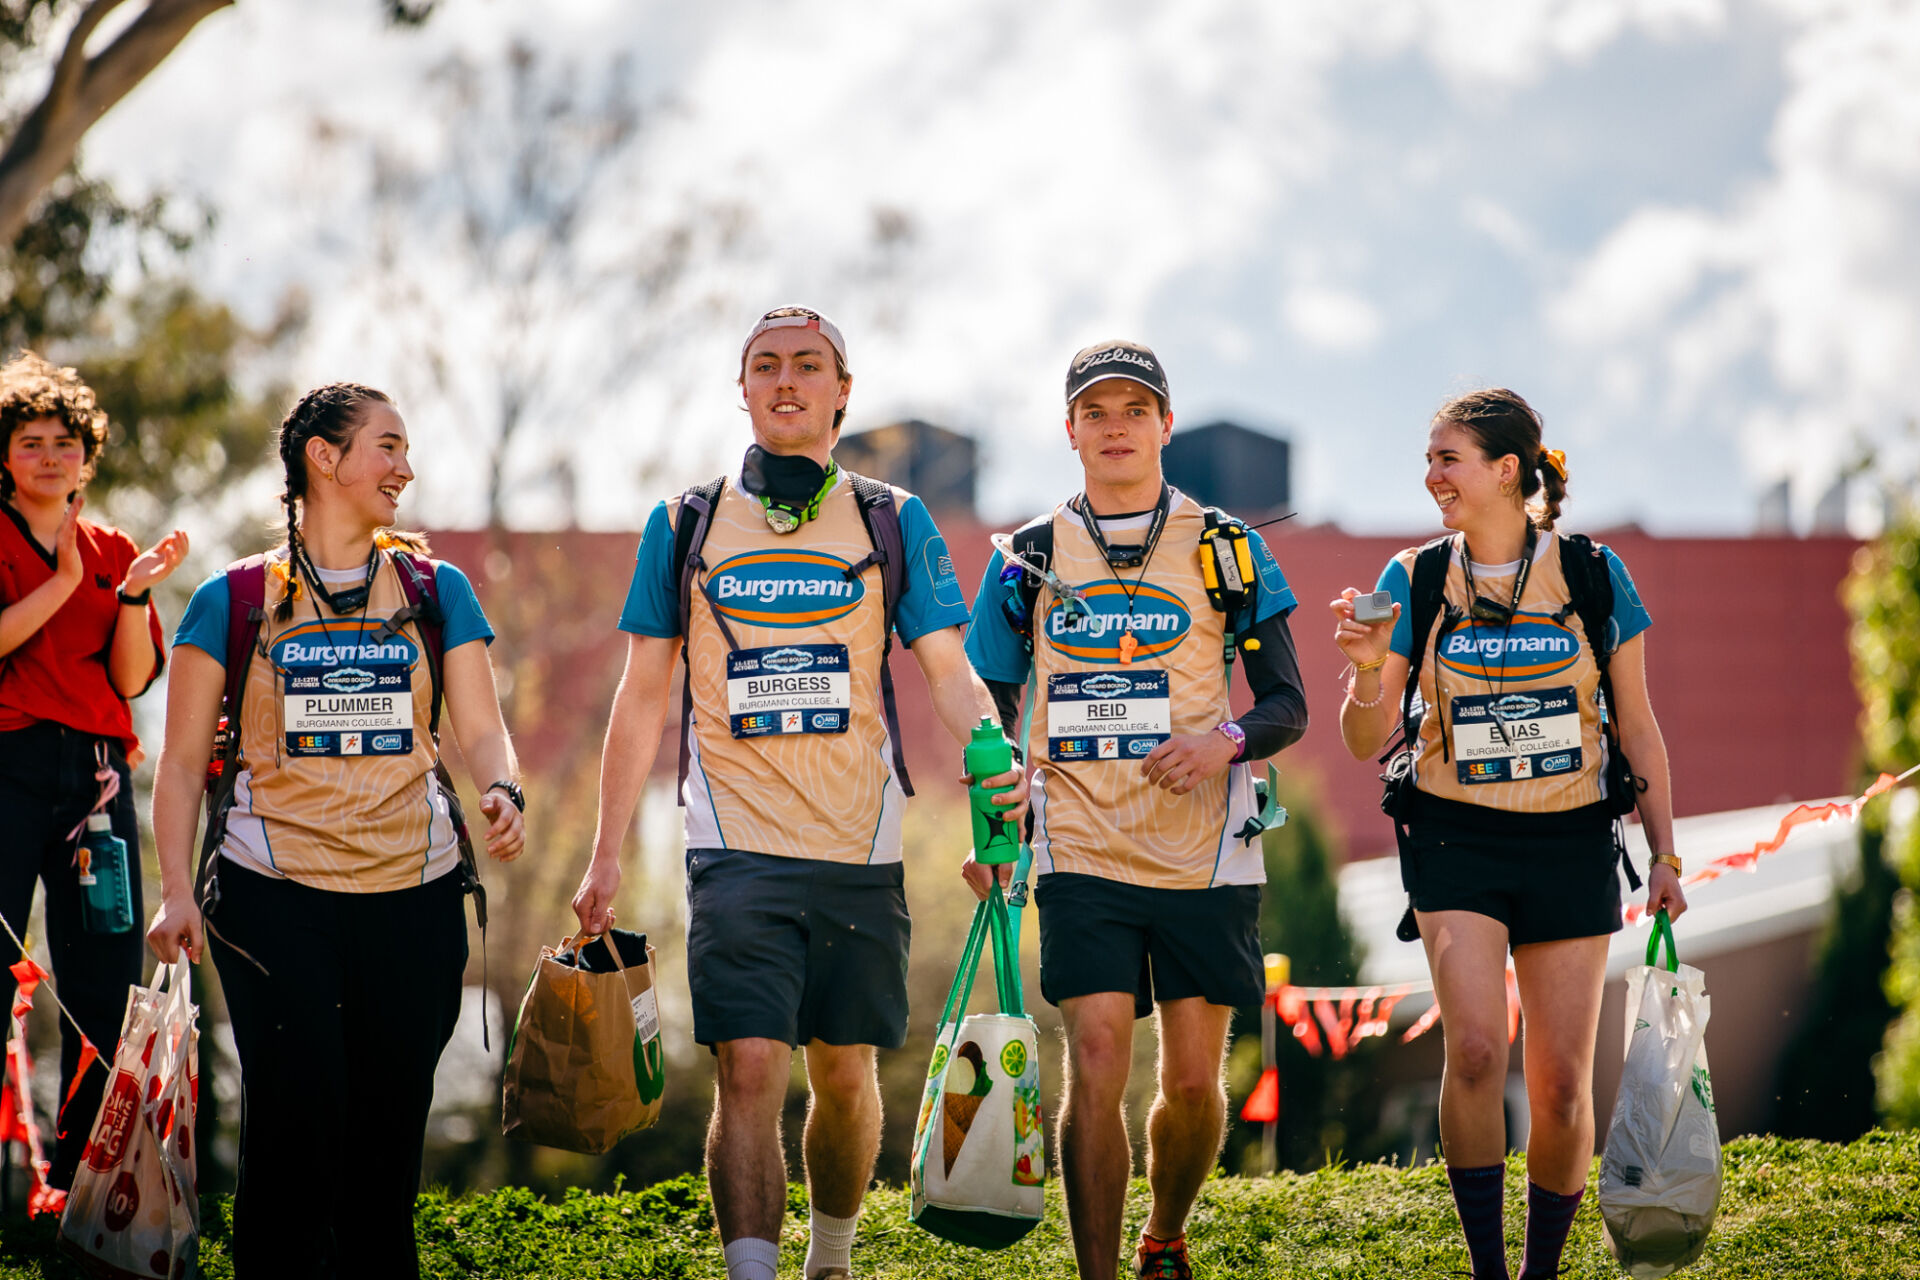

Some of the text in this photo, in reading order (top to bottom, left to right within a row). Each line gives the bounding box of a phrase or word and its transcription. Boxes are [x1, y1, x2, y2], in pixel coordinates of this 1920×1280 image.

[1076, 348, 1154, 374] Titleist
[718, 575, 853, 603] Burgmann
[1052, 611, 1178, 638] Burgmann
[1447, 635, 1570, 658] Burgmann
[282, 642, 408, 666] Burgmann
[817, 656, 840, 664] 2024
[379, 676, 402, 684] 2024
[748, 677, 830, 694] BURGESS
[306, 698, 393, 712] PLUMMER
[739, 700, 790, 710] BURGMANN
[1544, 699, 1568, 709] 2024
[1088, 704, 1126, 717] REID
[296, 720, 349, 728] BURGMANN
[742, 716, 772, 728] SEEF
[1058, 724, 1106, 733] BURGMANN
[1490, 723, 1540, 739] EIAS
[298, 736, 330, 747] SEEF
[1060, 741, 1088, 752] SEEF
[1466, 746, 1514, 756] BURGMAN
[1554, 756, 1568, 765] ANU
[1469, 762, 1500, 775] SEEF
[95, 1124, 123, 1156] AG
